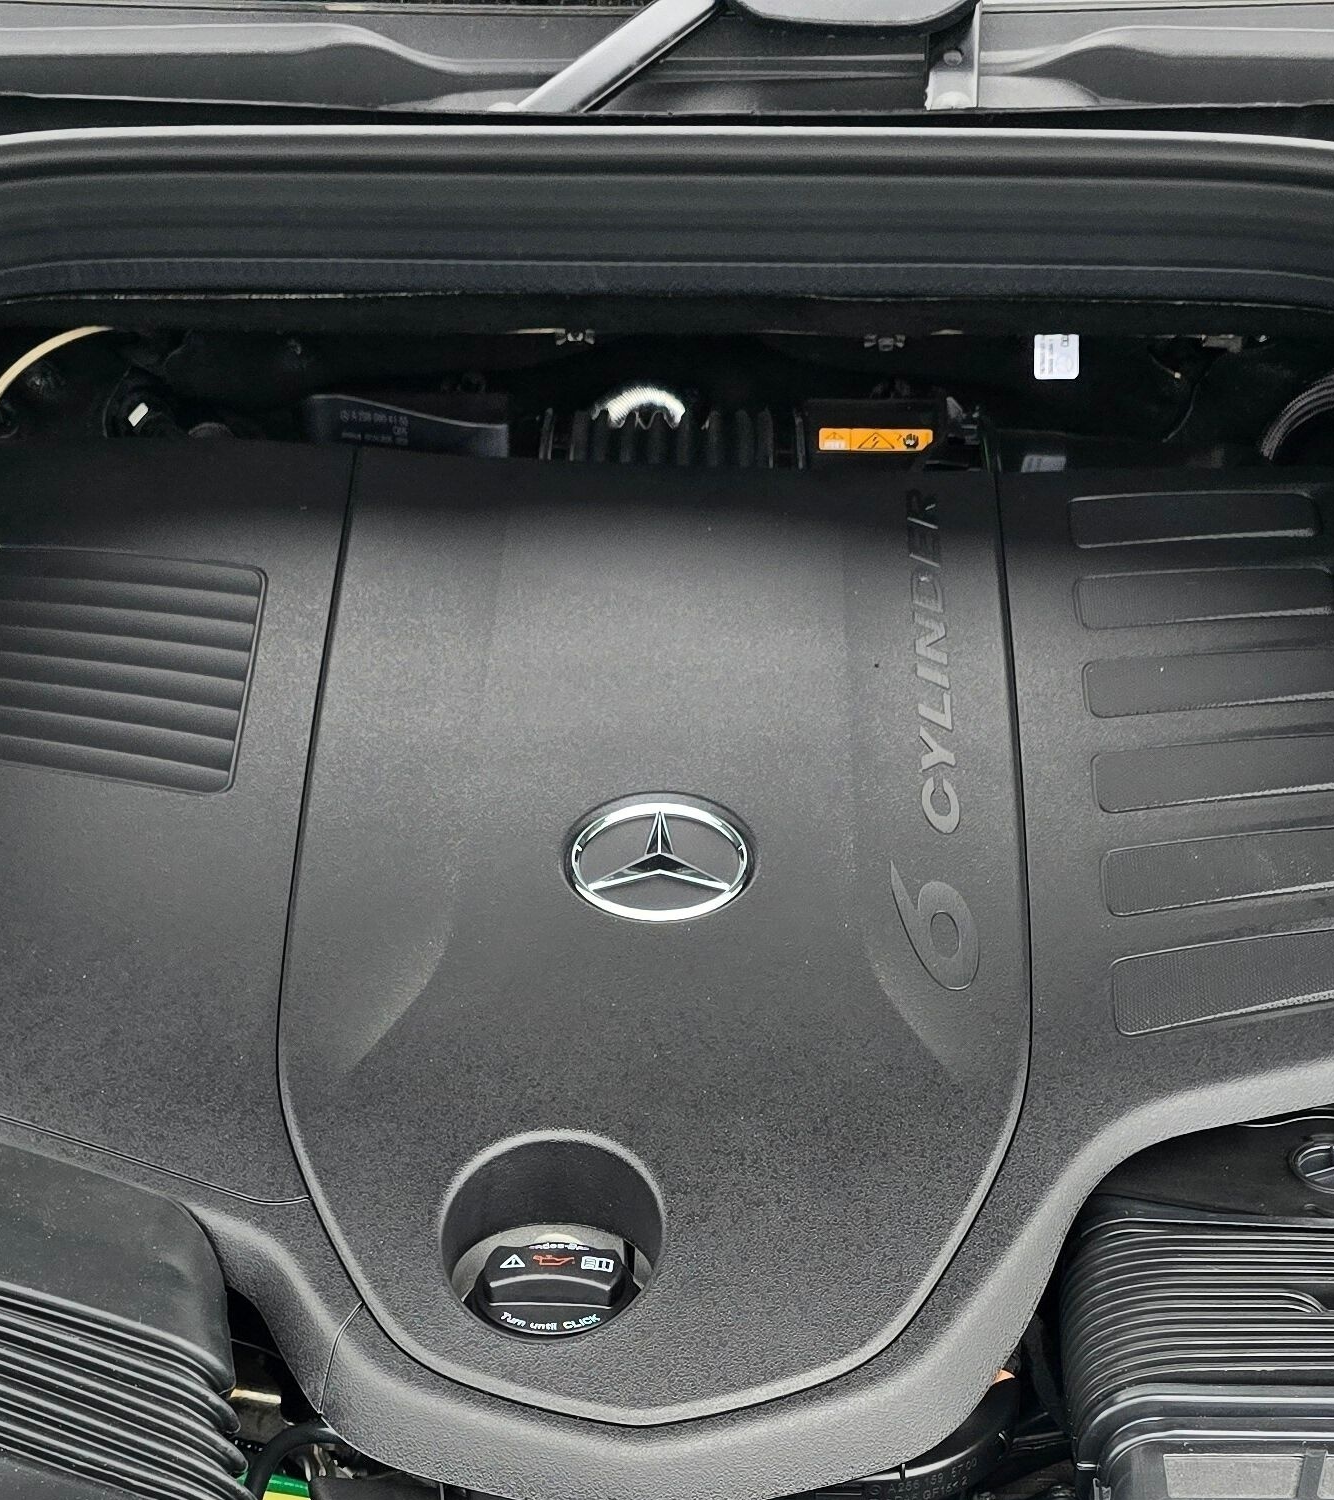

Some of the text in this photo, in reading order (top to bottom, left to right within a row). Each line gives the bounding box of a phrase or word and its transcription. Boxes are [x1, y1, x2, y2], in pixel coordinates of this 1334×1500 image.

[890, 487, 980, 991] 6 CYLINDER
[500, 1311, 601, 1331] Turn until CLICK
